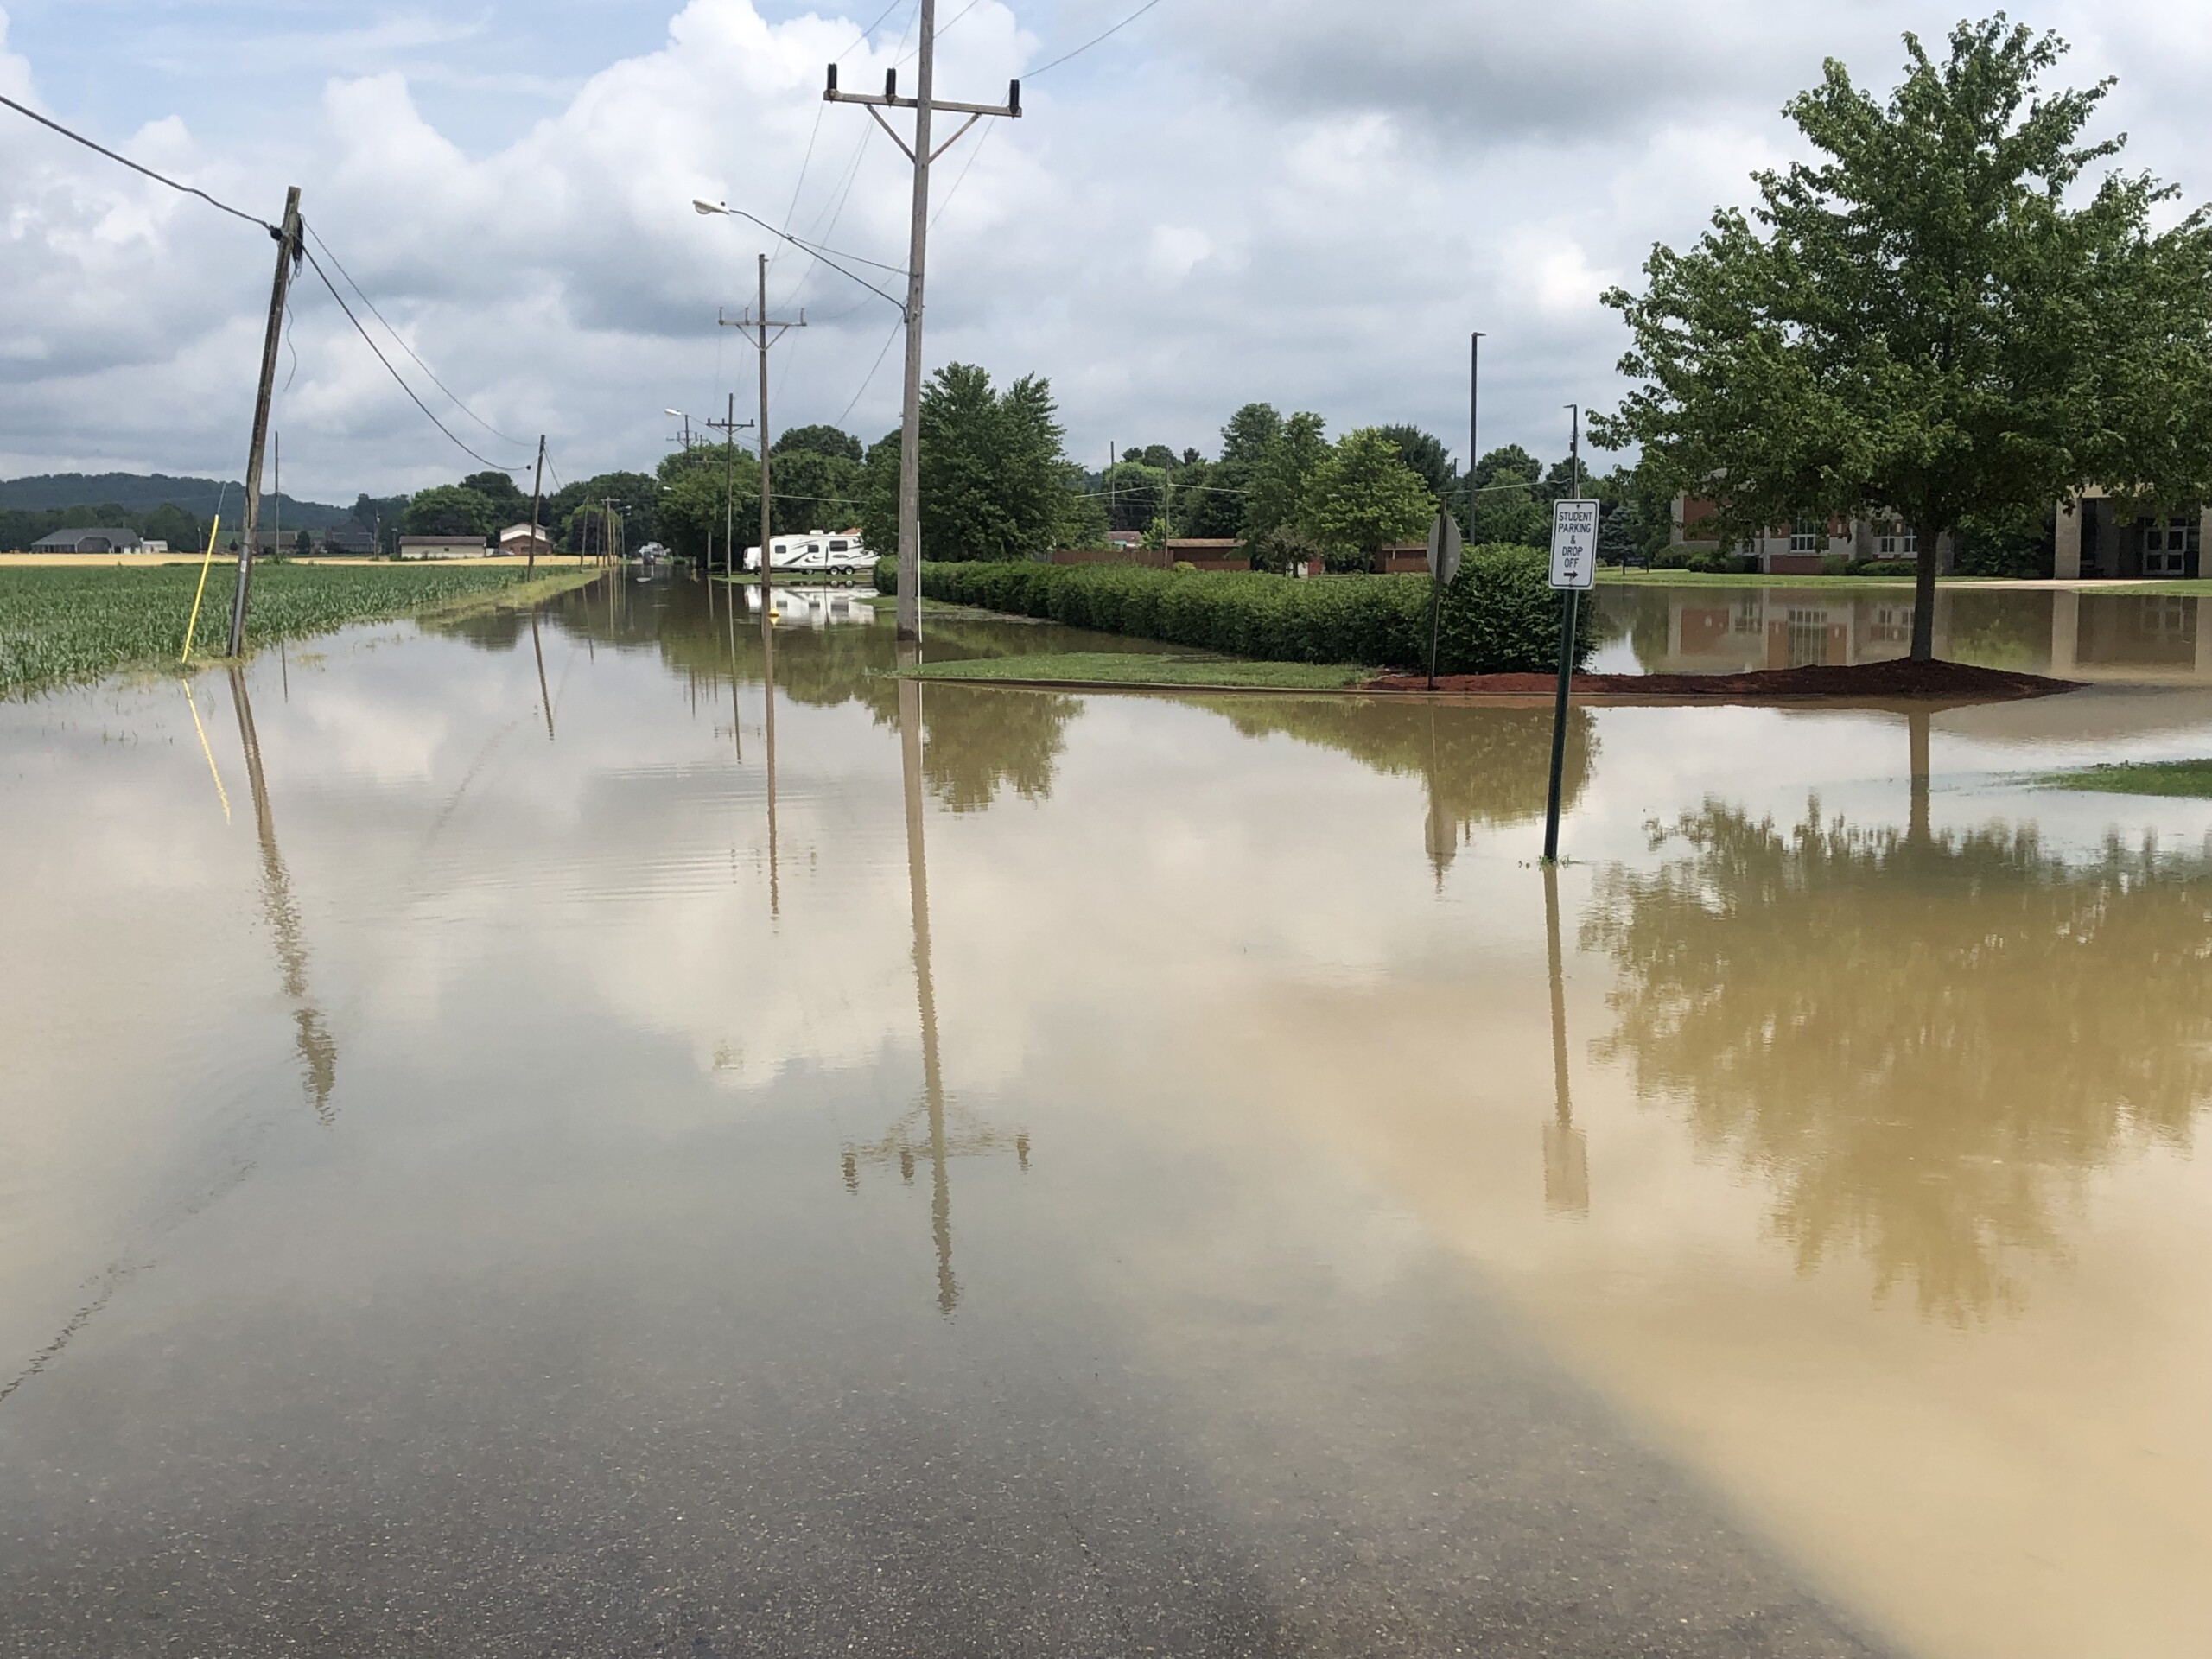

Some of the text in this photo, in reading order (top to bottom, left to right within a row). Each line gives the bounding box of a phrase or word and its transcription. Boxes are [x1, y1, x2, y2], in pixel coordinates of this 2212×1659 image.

[1559, 512, 1592, 521] STUDENT
[1558, 524, 1591, 533] PARKING
[1570, 535, 1576, 544] &
[1562, 546, 1583, 556] DROP
[1564, 558, 1579, 568] OFF
